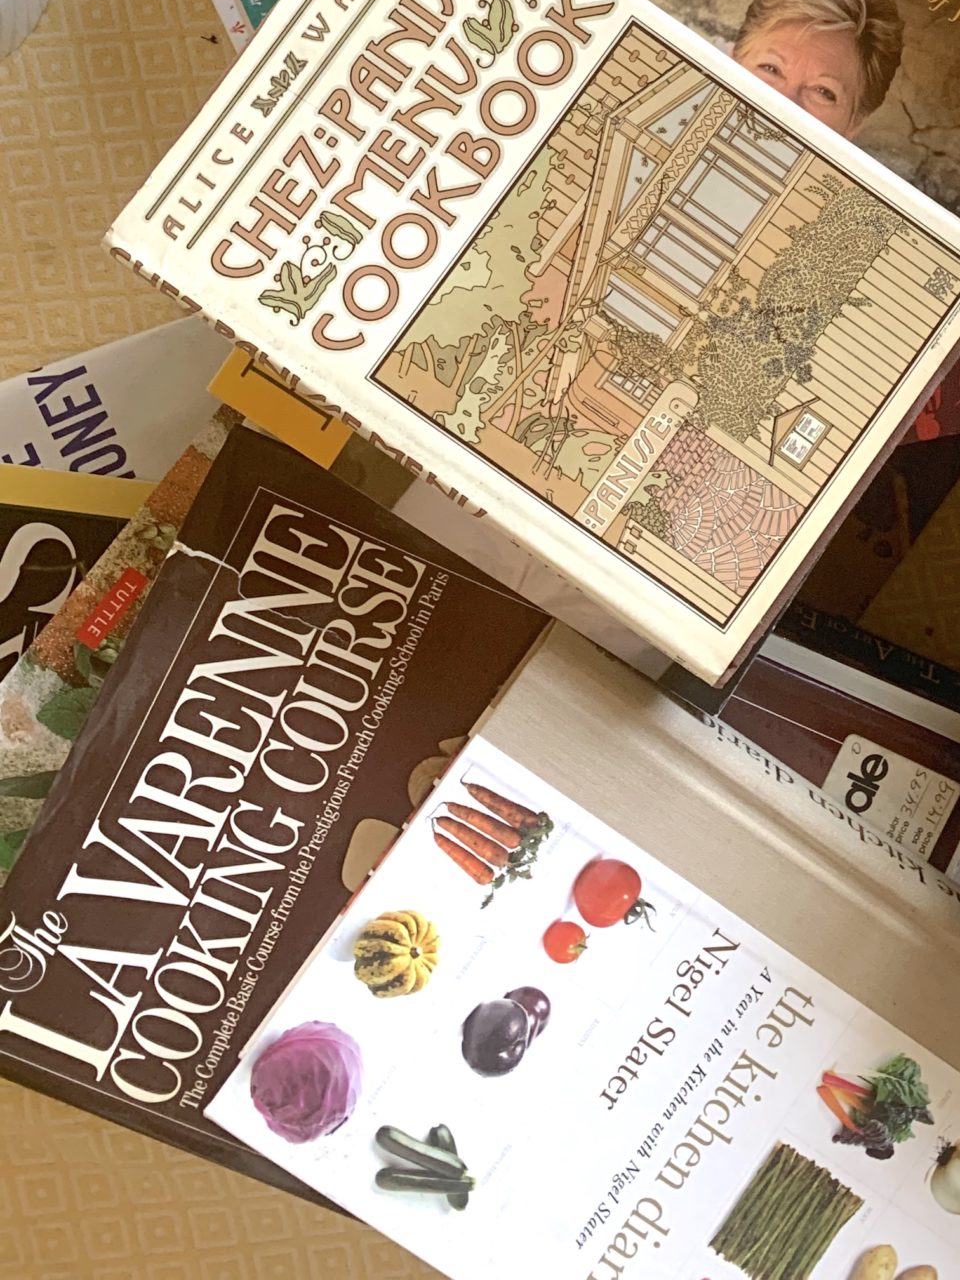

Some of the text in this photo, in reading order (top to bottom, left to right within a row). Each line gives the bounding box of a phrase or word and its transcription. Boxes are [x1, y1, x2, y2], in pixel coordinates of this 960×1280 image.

[163, 123, 254, 240] ALICE
[330, 36, 480, 230] MENU
[87, 579, 138, 638] TUTTLE
[56, 503, 362, 915] VARENNE
[109, 796, 306, 1105] COOKING
[257, 541, 428, 794] COURSE
[179, 570, 450, 1110] The Complete Basic Course from the Prestigious French Cooking School in Paris
[900, 768, 928, 818] 34.95
[912, 826, 925, 845] sale
[918, 780, 956, 855] price 14.99
[0, 910, 69, 994] The
[0, 942, 163, 1083] LA
[598, 927, 742, 1111] Nigel Slater
[575, 966, 773, 1251] A Year in the Kitchen with Nigel Slater
[654, 986, 816, 1191] the kitchen
